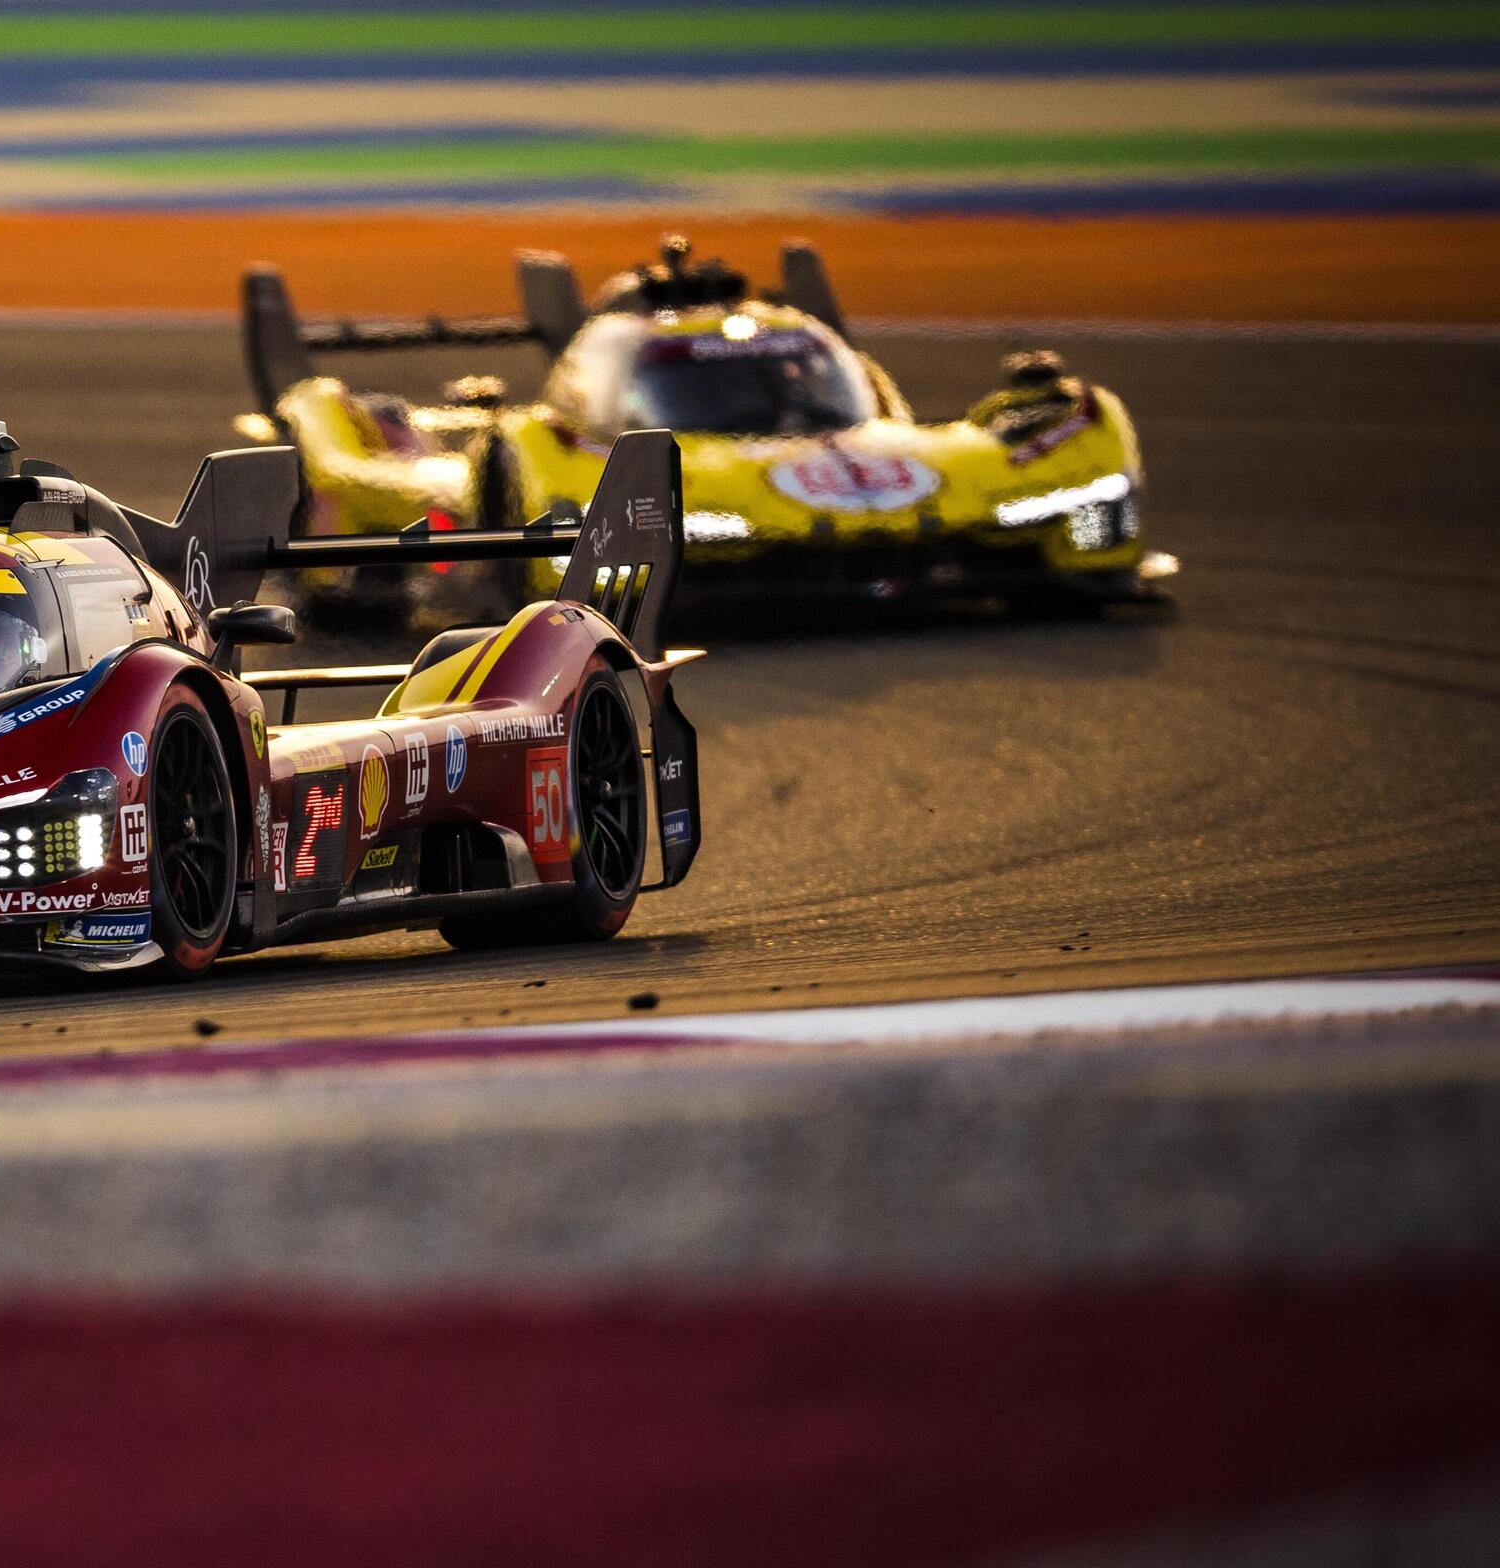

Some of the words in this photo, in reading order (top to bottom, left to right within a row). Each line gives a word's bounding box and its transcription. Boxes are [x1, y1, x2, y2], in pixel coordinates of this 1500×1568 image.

[17, 689, 86, 723] GROUP
[480, 717, 528, 743] RICHARD
[529, 714, 565, 738] MILLE
[127, 733, 145, 775] hp
[448, 727, 465, 790] hp
[531, 768, 563, 843] 50
[87, 924, 146, 937] MICHELIN
